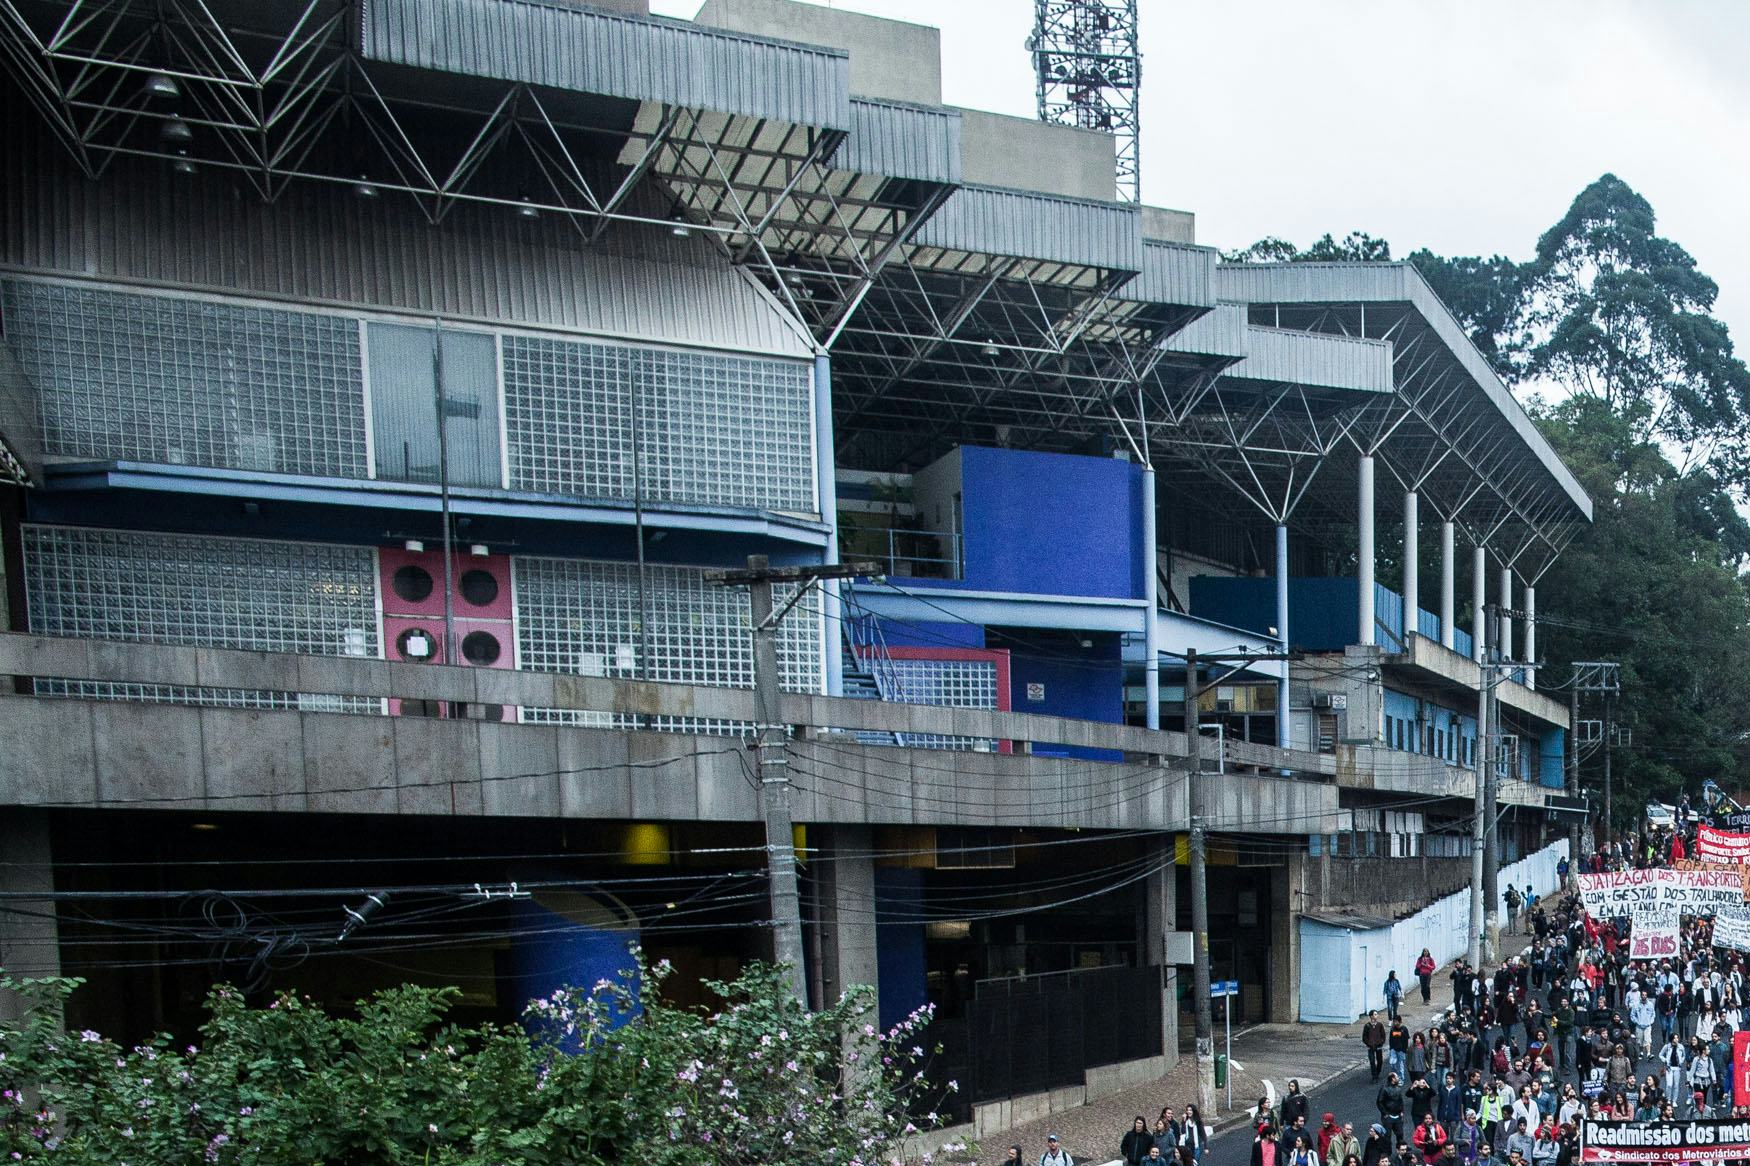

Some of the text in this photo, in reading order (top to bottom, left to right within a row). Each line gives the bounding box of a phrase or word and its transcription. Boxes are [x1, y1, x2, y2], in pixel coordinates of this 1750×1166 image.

[1664, 887, 1687, 901] DOS
[1586, 1121, 1682, 1146] Readmissão
[1686, 1121, 1715, 1144] dos
[1614, 1149, 1660, 1161] Sindicato
[1663, 1150, 1681, 1161] dos
[1682, 1148, 1743, 1161] Metroviários
